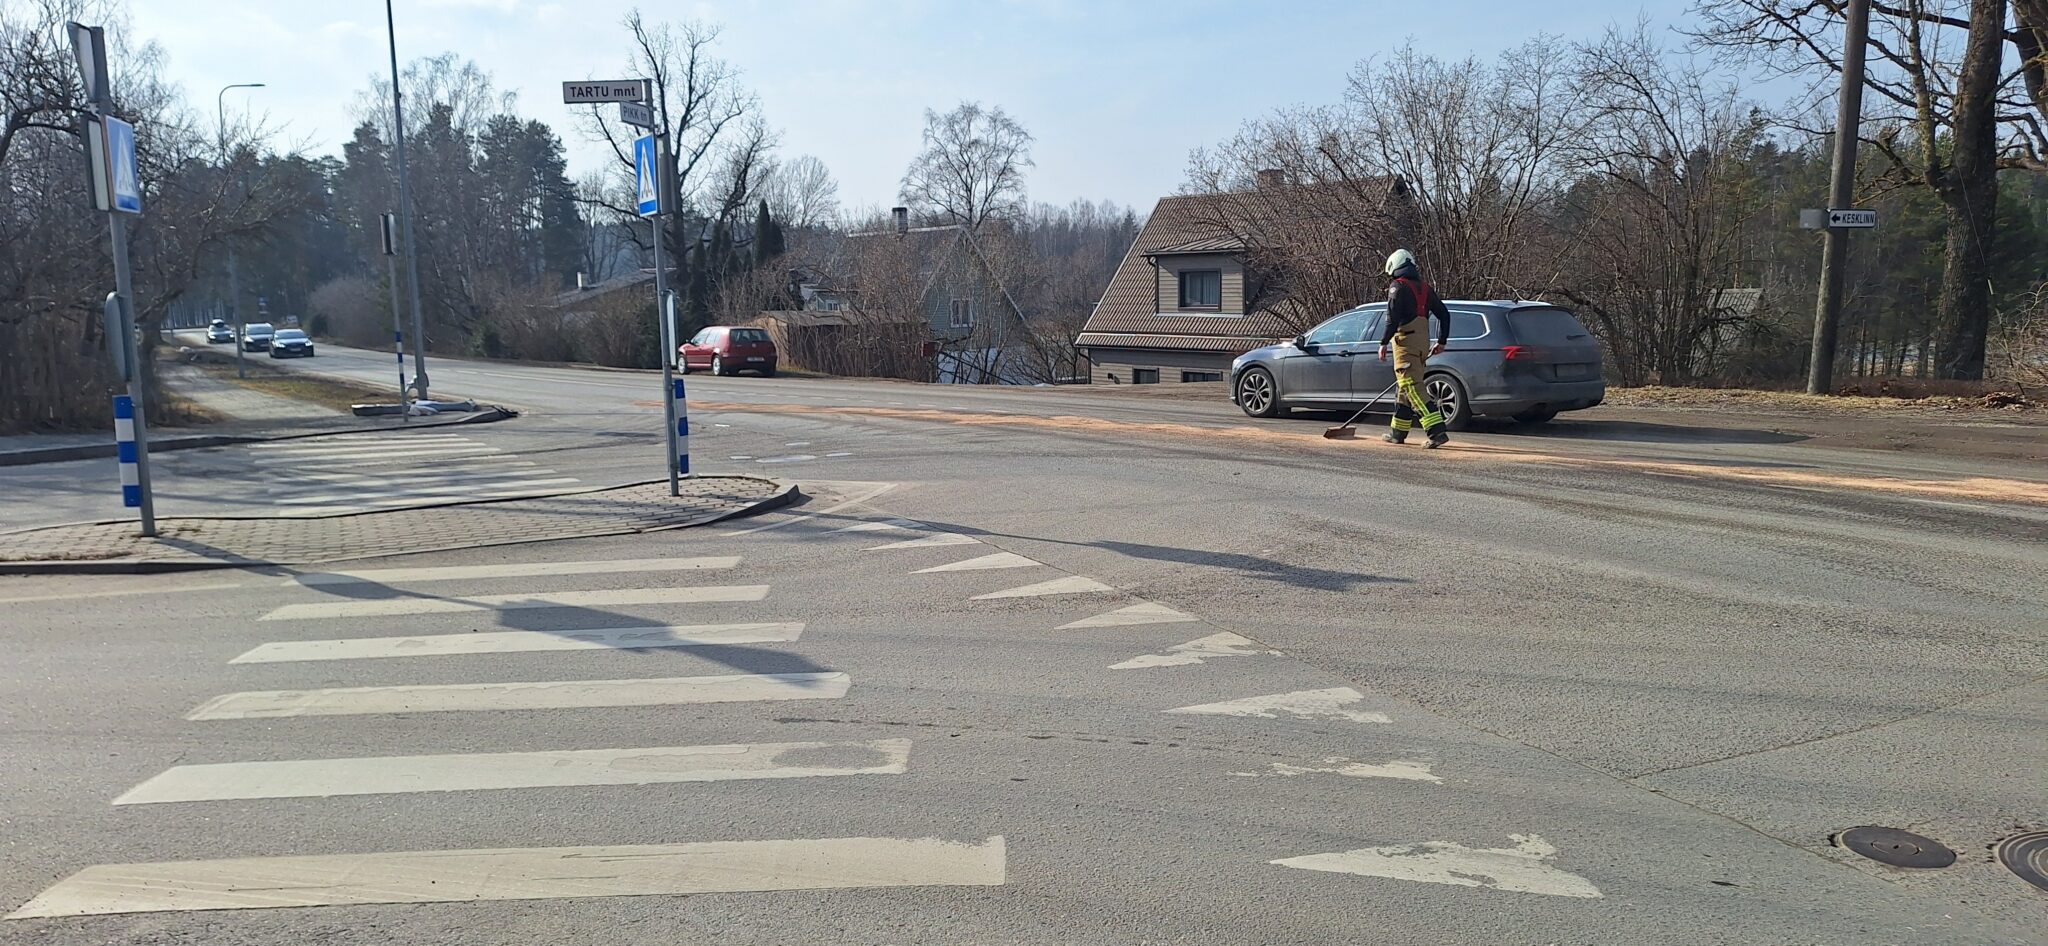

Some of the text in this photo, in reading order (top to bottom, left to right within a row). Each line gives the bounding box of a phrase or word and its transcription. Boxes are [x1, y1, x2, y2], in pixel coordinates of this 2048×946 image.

[570, 86, 636, 98] TARTU mnt
[623, 106, 640, 120] PIKK
[1842, 213, 1875, 224] KESKLINN
